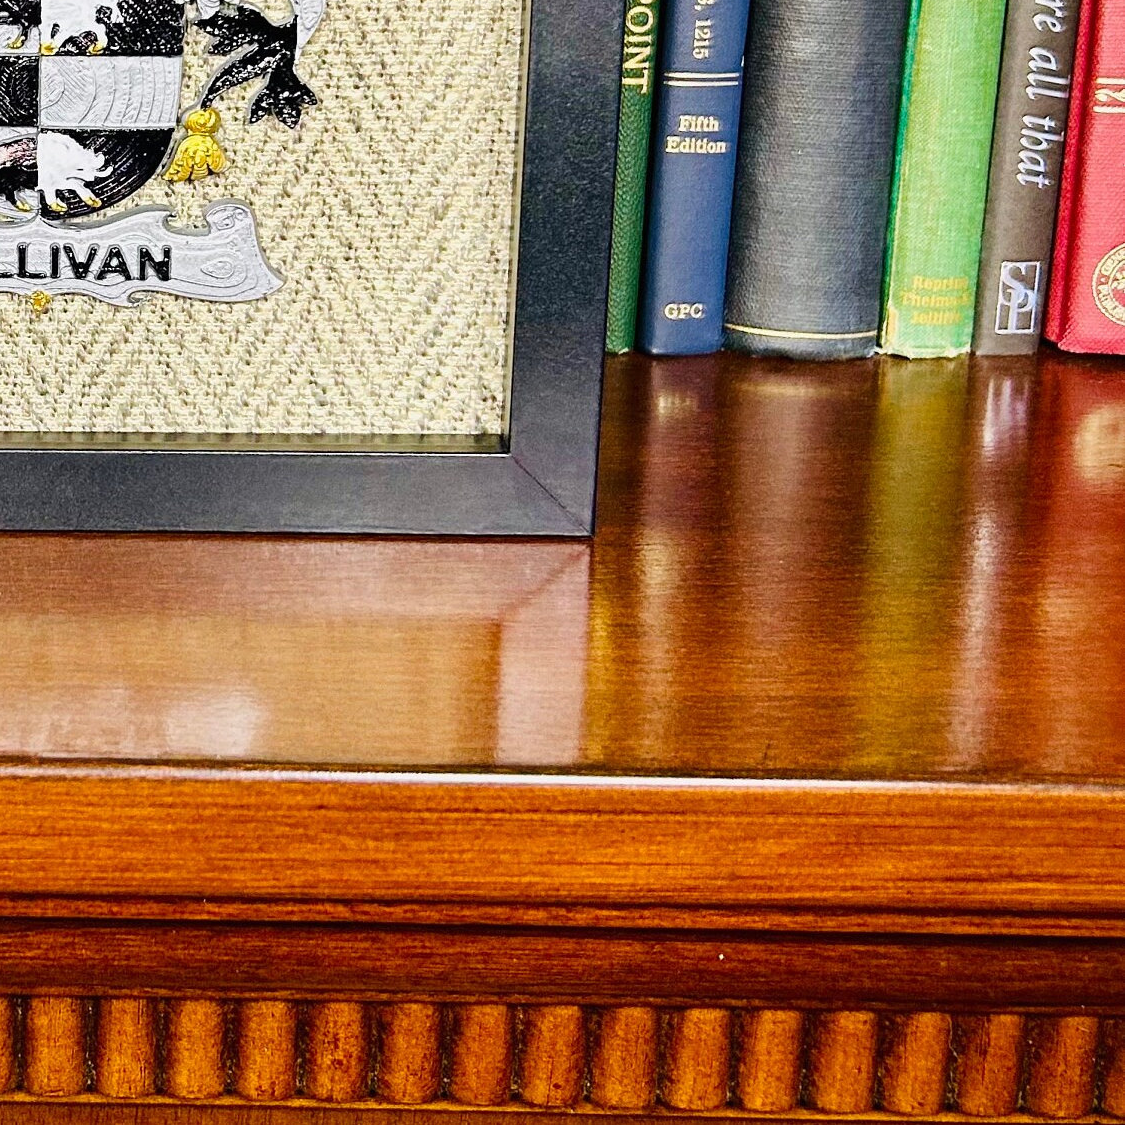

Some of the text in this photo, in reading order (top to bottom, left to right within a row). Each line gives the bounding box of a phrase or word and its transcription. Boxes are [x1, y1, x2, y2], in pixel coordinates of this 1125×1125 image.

[692, 18, 712, 60] 1215
[1025, 46, 1070, 102] all
[678, 115, 720, 133] Fifth
[665, 135, 727, 154] Edition
[1015, 114, 1065, 190] that
[663, 303, 704, 320] GPC
